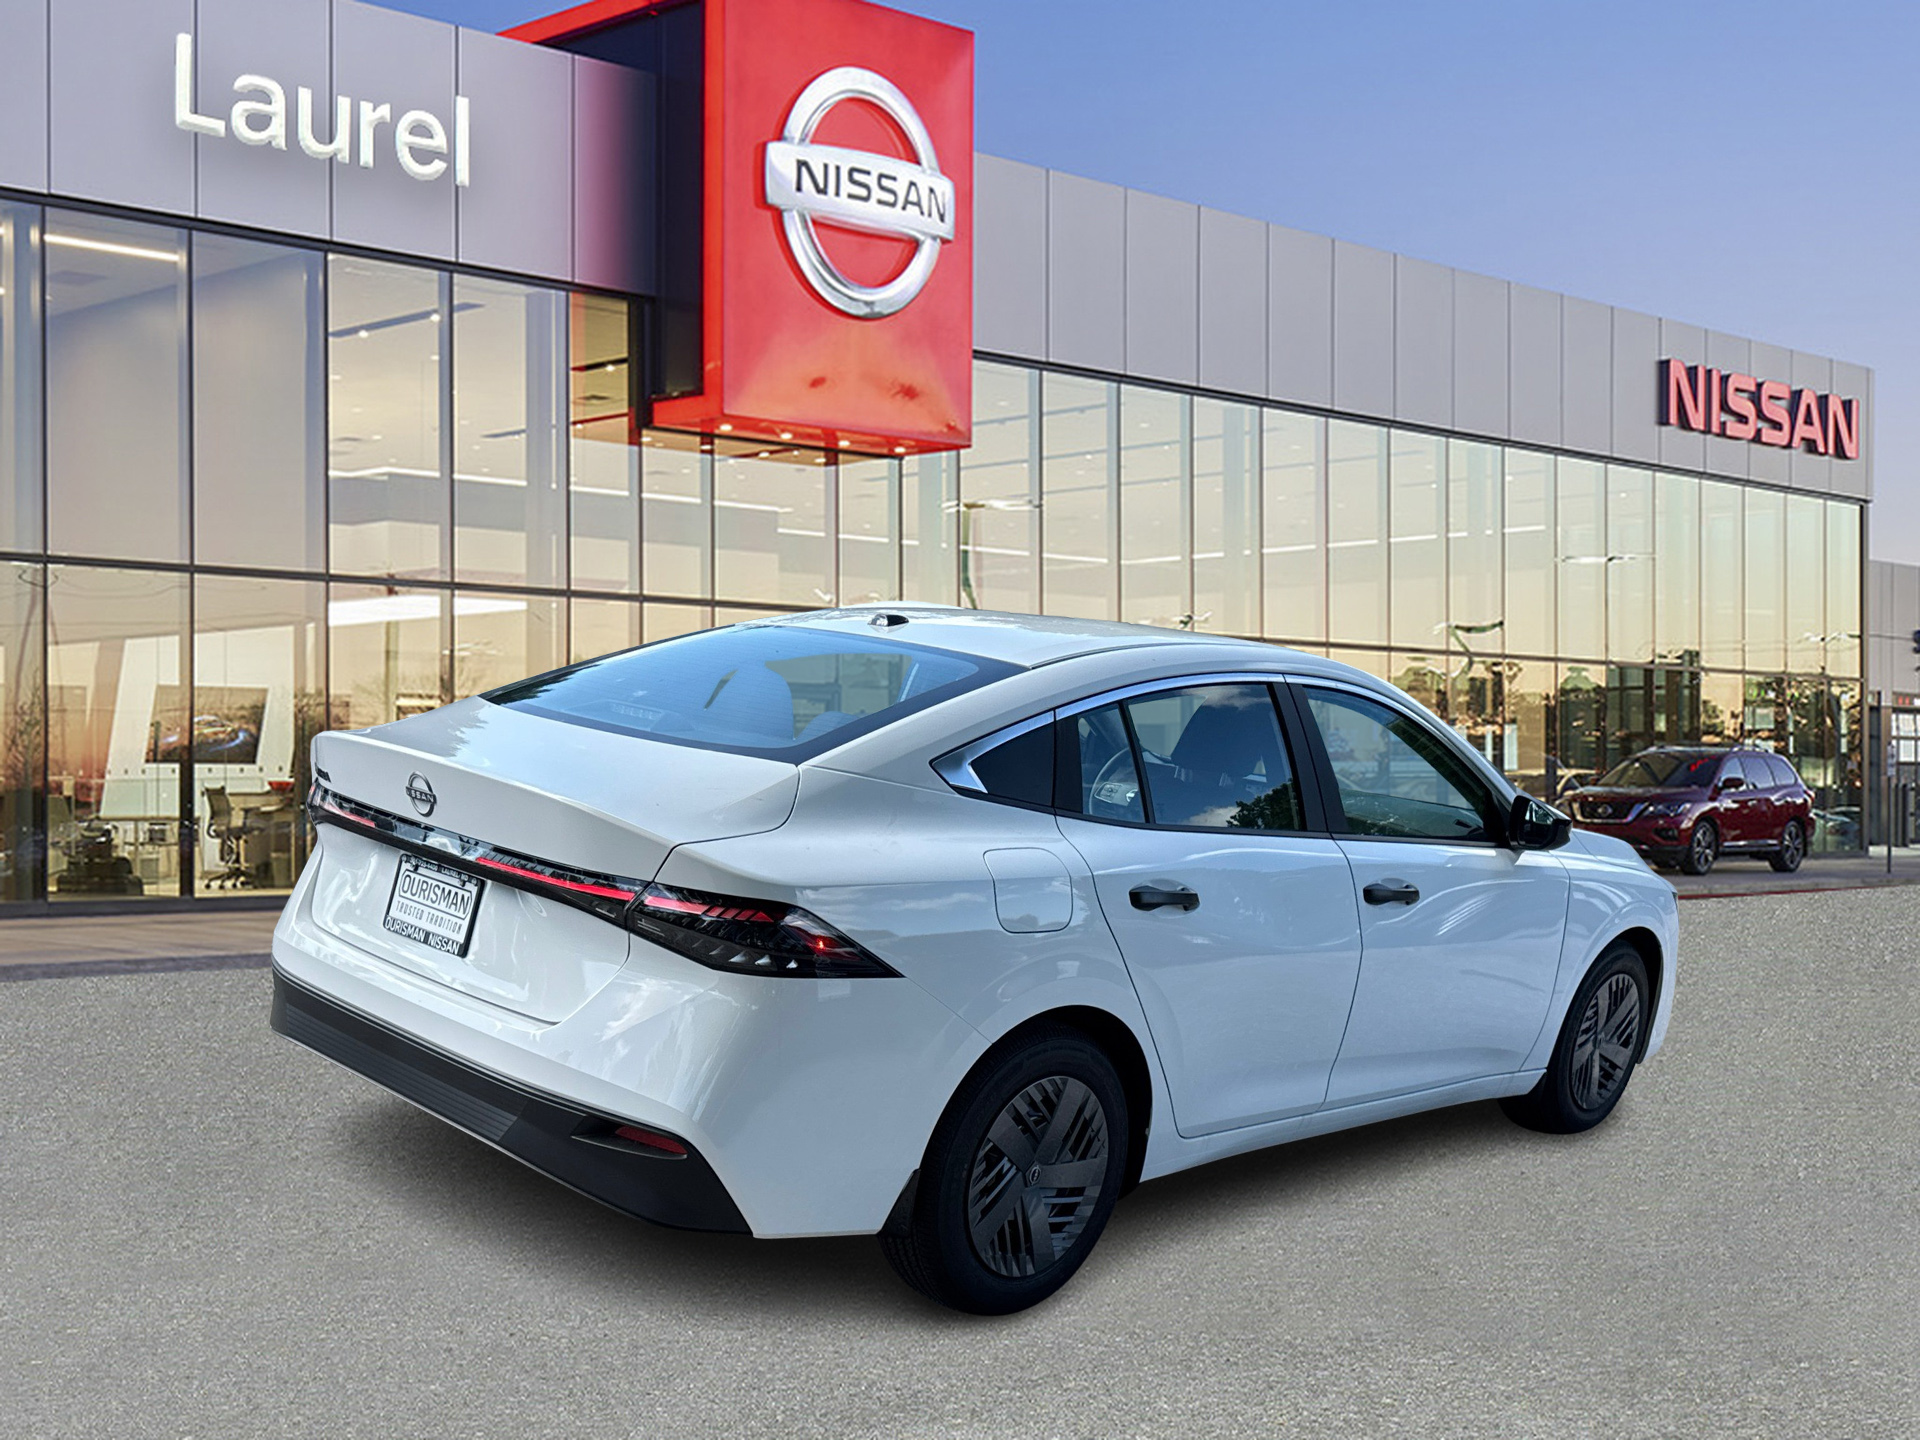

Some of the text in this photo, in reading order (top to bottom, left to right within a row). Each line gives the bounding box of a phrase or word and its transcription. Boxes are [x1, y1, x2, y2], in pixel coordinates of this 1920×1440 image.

[175, 32, 470, 188] Laurel
[794, 158, 947, 224] NISSAN
[1657, 358, 1860, 460] NISSAN
[395, 900, 463, 935] TRUSTED TRADITION
[401, 874, 470, 915] OURISMAN
[384, 917, 460, 955] OURISMAN NISSAN
